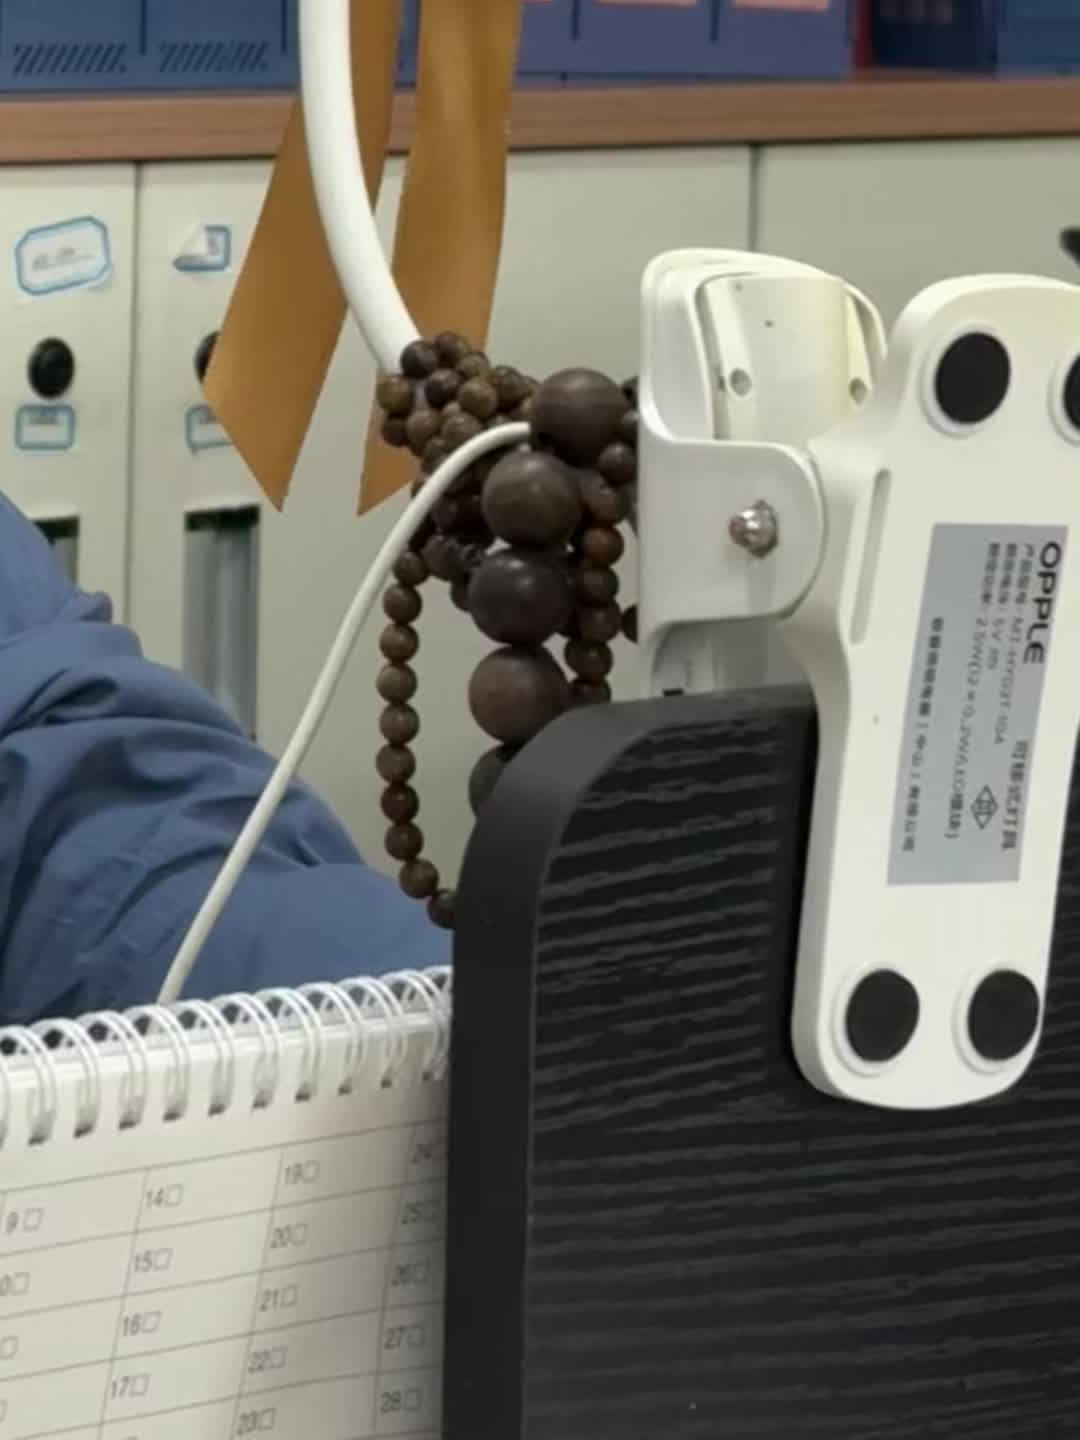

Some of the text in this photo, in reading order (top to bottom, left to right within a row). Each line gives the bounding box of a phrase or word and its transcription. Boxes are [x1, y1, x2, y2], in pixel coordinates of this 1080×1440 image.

[1022, 541, 1063, 664] OPPLE
[145, 1188, 164, 1208] 14
[5, 1211, 19, 1235] 9
[134, 1249, 153, 1272] 15
[260, 1289, 280, 1311] 21
[123, 1313, 142, 1336] 16
[384, 1325, 404, 1350] 27
[111, 1375, 130, 1400] 17
[379, 1389, 401, 1414] 28
